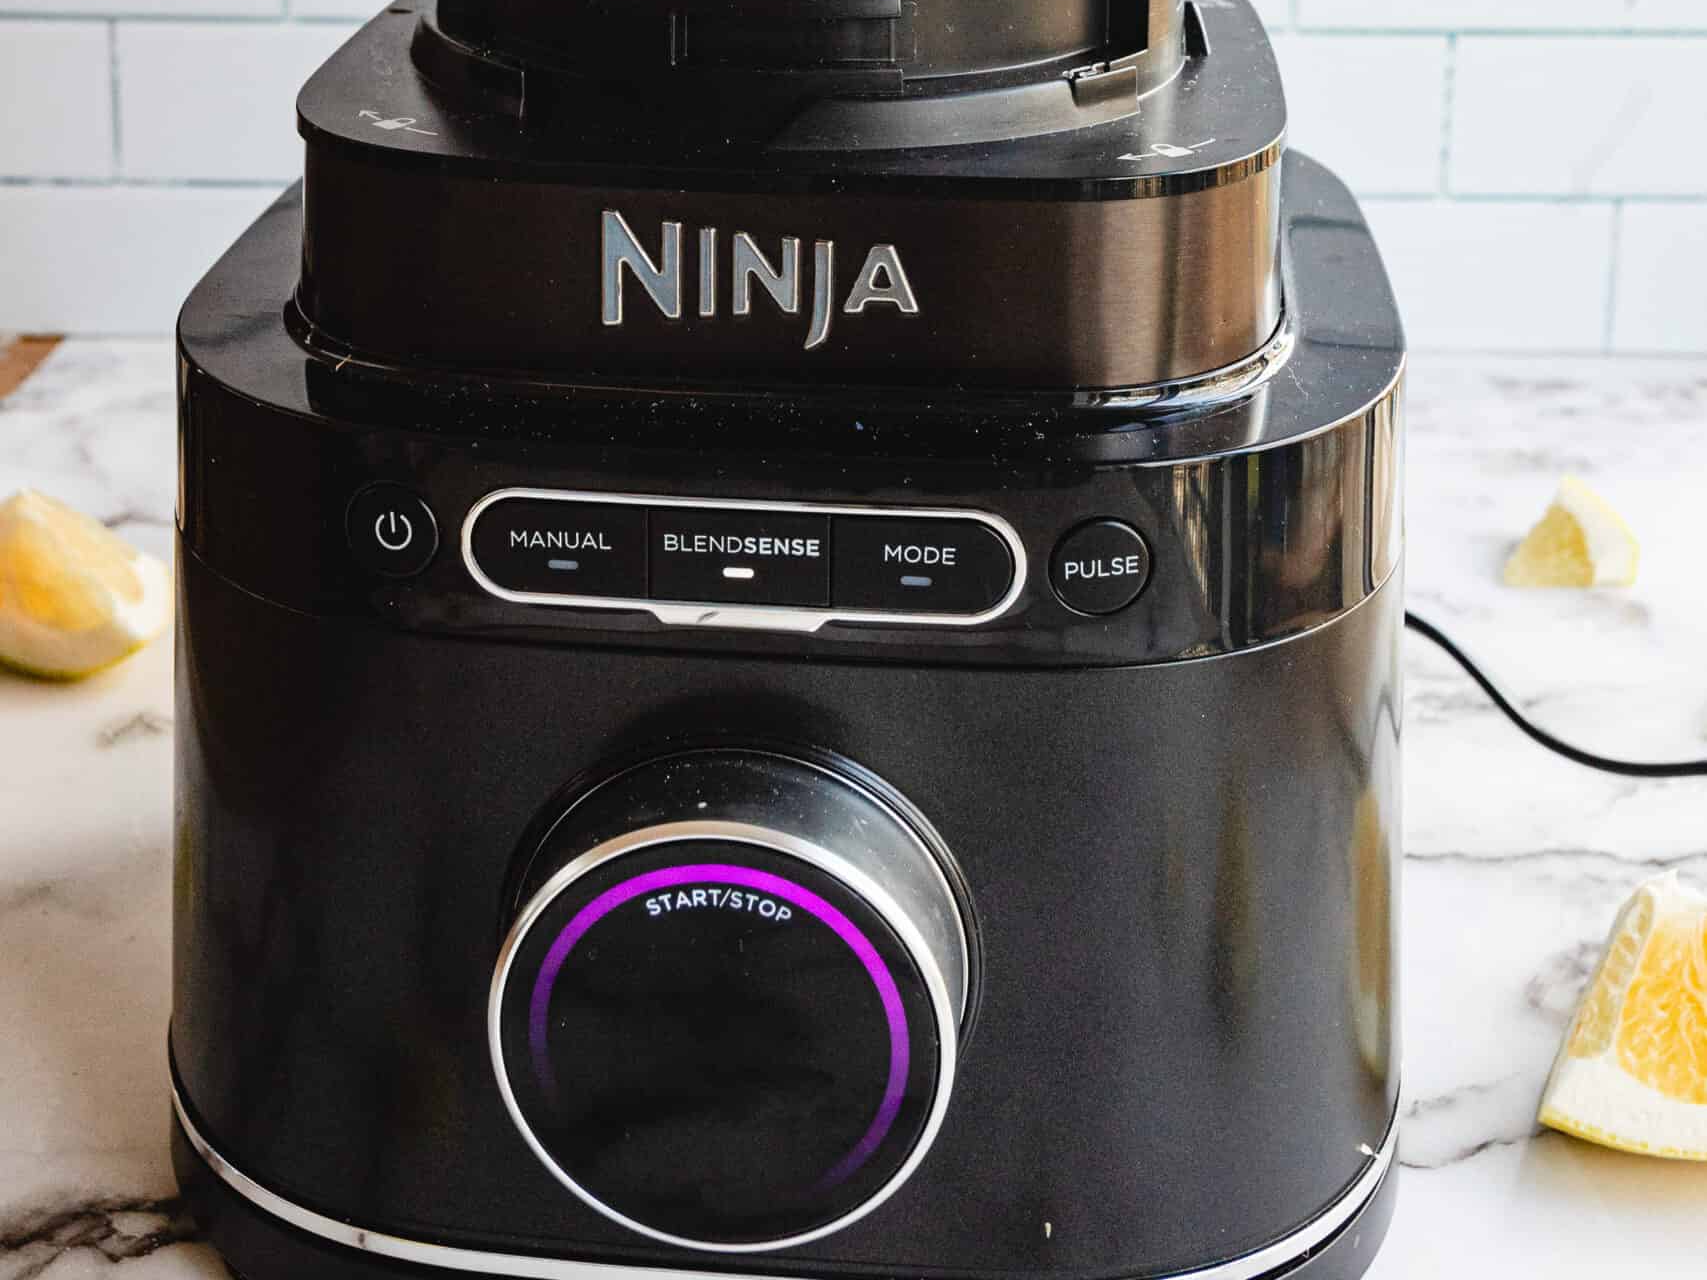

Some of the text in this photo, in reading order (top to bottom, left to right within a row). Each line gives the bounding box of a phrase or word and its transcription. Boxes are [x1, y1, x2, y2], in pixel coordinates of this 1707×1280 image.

[602, 210, 919, 350] NINJA
[510, 529, 612, 551] MANUAL
[663, 533, 820, 557] BLENDSENSE
[884, 543, 957, 566] MODE
[1064, 554, 1140, 581] PULSE
[645, 887, 793, 923] START/STOP
